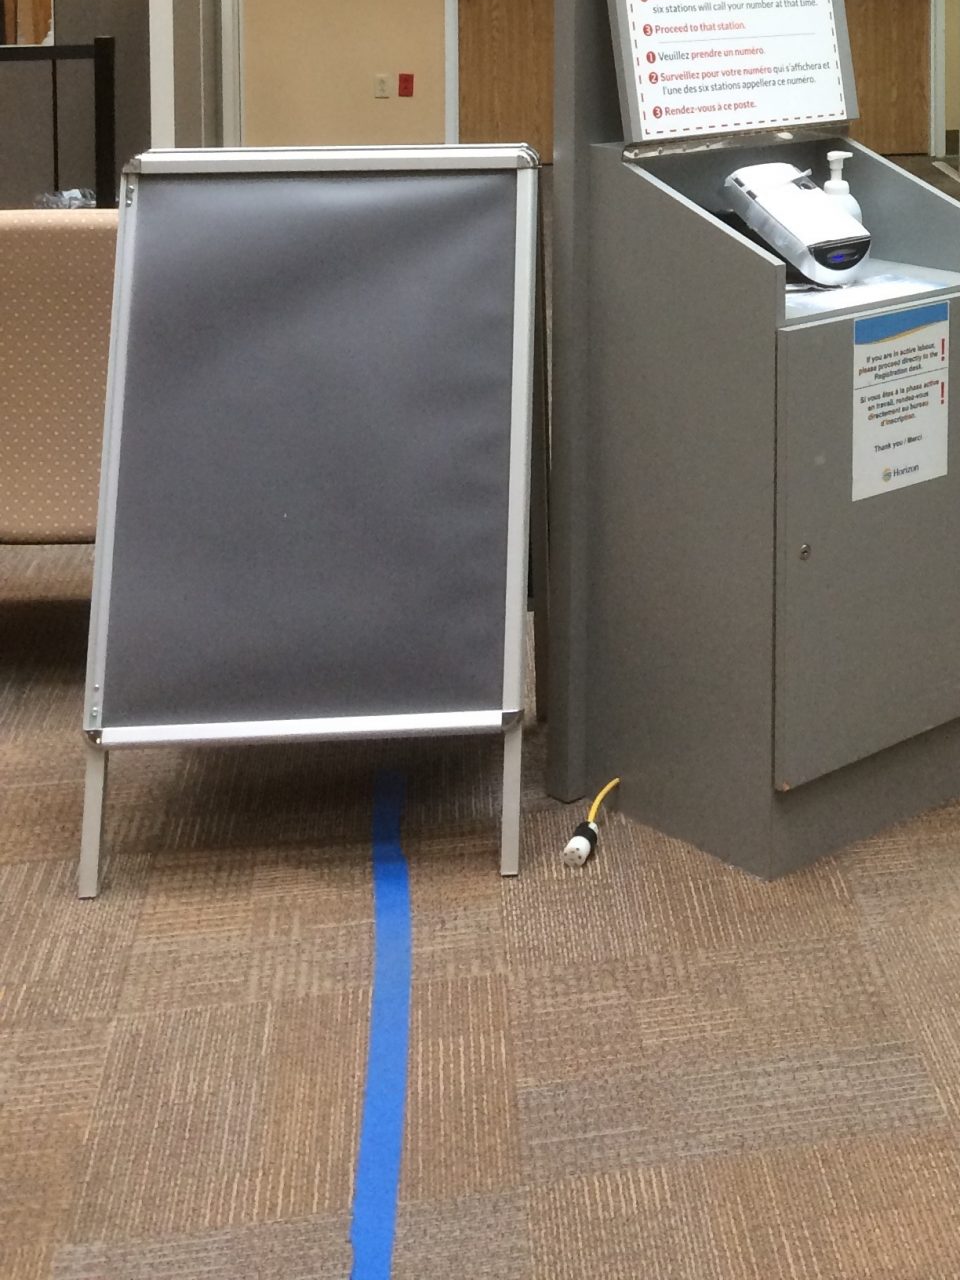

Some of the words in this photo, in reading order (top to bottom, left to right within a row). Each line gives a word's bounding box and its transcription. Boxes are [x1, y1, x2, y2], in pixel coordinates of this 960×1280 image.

[652, 5, 664, 14] six
[665, 3, 697, 13] stations
[698, 2, 711, 11] will
[713, 2, 726, 11] call
[727, 2, 744, 11] your
[746, 0, 774, 9] number
[775, 0, 782, 8] at
[783, 0, 798, 7] that
[655, 23, 688, 34] Proceed
[690, 23, 698, 32] to
[700, 22, 716, 31] that
[717, 21, 746, 30] station.
[658, 51, 689, 61] Veuillez
[691, 48, 722, 59] prendre
[724, 49, 733, 57] un
[660, 70, 700, 81] Surveillez
[702, 70, 719, 79] pour
[721, 67, 742, 76] votre
[743, 65, 772, 75] numéro
[773, 65, 785, 74] qui
[786, 61, 822, 72] s'affichera
[823, 61, 830, 69] et
[662, 85, 682, 95] l'une
[684, 84, 697, 94] des
[698, 84, 709, 93] six
[711, 81, 741, 91] stations
[742, 77, 776, 90] appellera
[777, 78, 785, 86] ce
[787, 75, 816, 85] numéro.
[664, 103, 716, 116] Rendez-vous
[717, 103, 722, 111] à
[723, 103, 732, 111] ce
[733, 100, 757, 111] poste.
[872, 354, 882, 363] you
[883, 352, 892, 360] are
[900, 346, 916, 355] active
[858, 366, 877, 376] please
[878, 359, 900, 371] proceed
[902, 355, 921, 365] directly
[929, 350, 939, 358] the
[874, 367, 908, 380] Registration
[860, 395, 866, 404] Si
[906, 383, 922, 393] phase
[923, 379, 939, 388] active
[909, 401, 929, 410] bureau
[874, 442, 891, 453] Thank
[892, 440, 903, 449] you
[907, 434, 922, 444] Merci
[893, 464, 919, 477] Horizon
